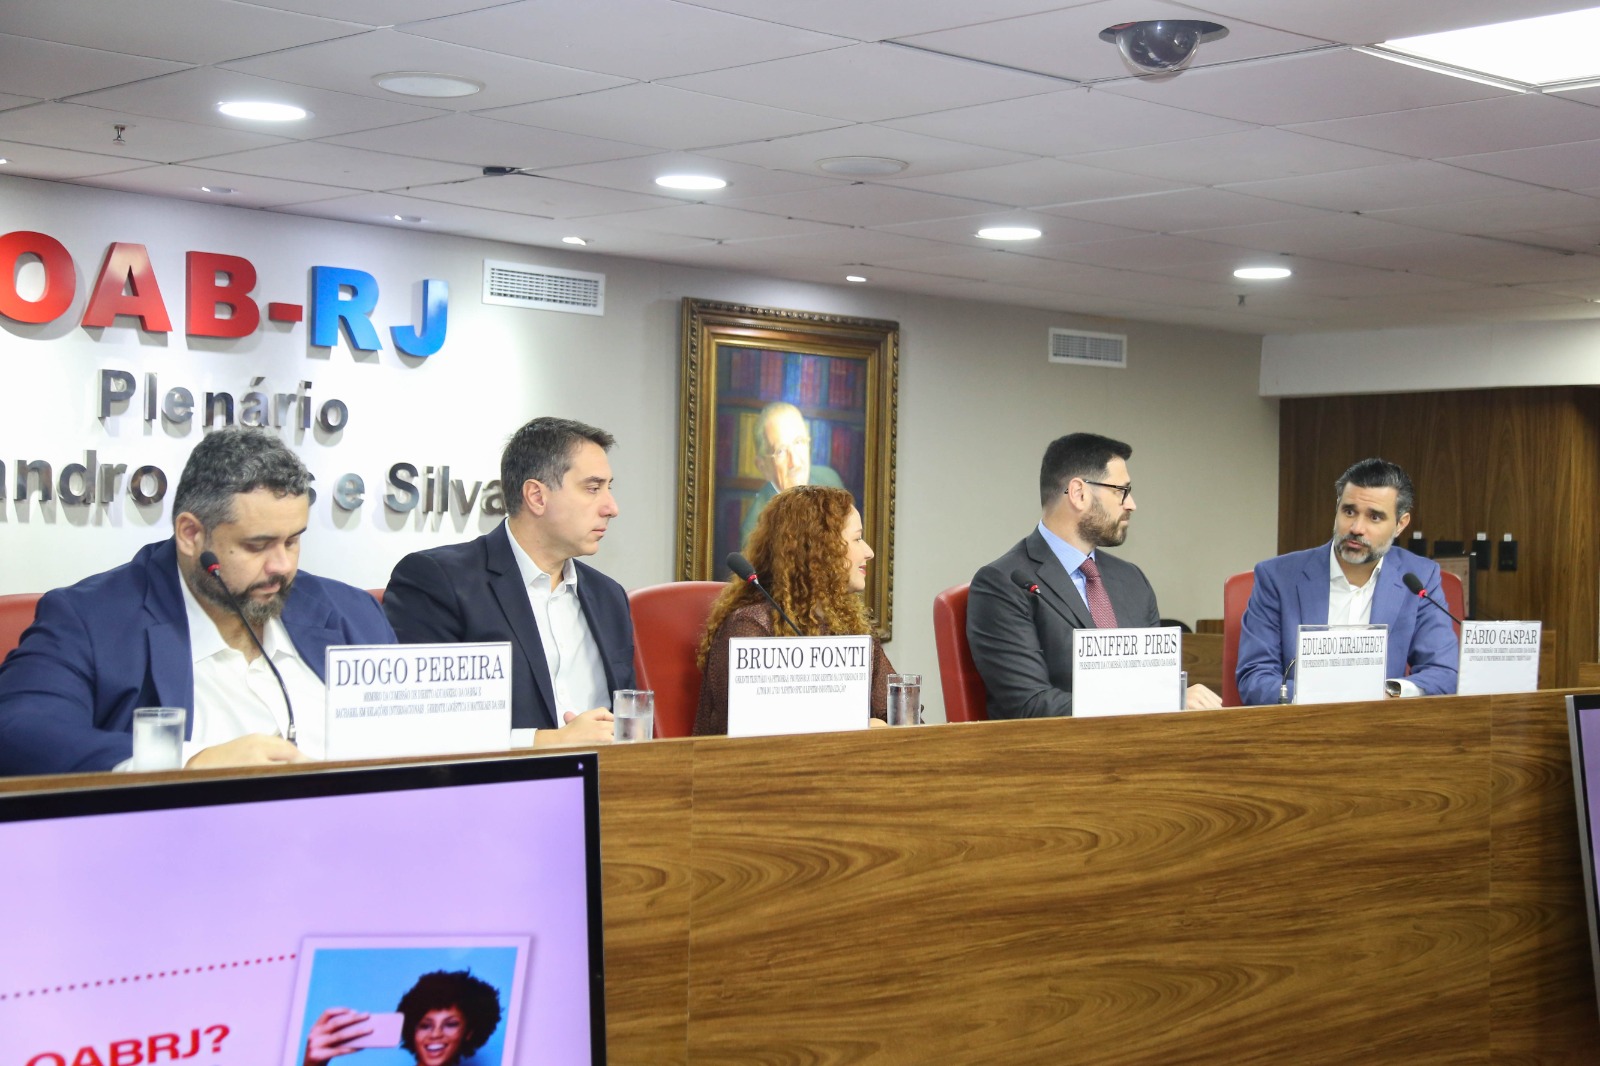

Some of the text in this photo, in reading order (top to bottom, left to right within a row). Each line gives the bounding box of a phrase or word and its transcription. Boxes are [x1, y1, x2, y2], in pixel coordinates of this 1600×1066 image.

[0, 230, 449, 357] OAB-RJ
[98, 368, 349, 433] Plenário
[0, 449, 168, 505] ndro
[333, 472, 365, 511] e
[1079, 633, 1177, 657] JENIFFER PIRES
[1302, 635, 1385, 656] EDUARDO KIRALYHEGY
[1465, 625, 1538, 645] FÁBIO GASPAR
[336, 654, 505, 687] DIOGO PEREIRA
[736, 646, 866, 670] BRUNO FONTI
